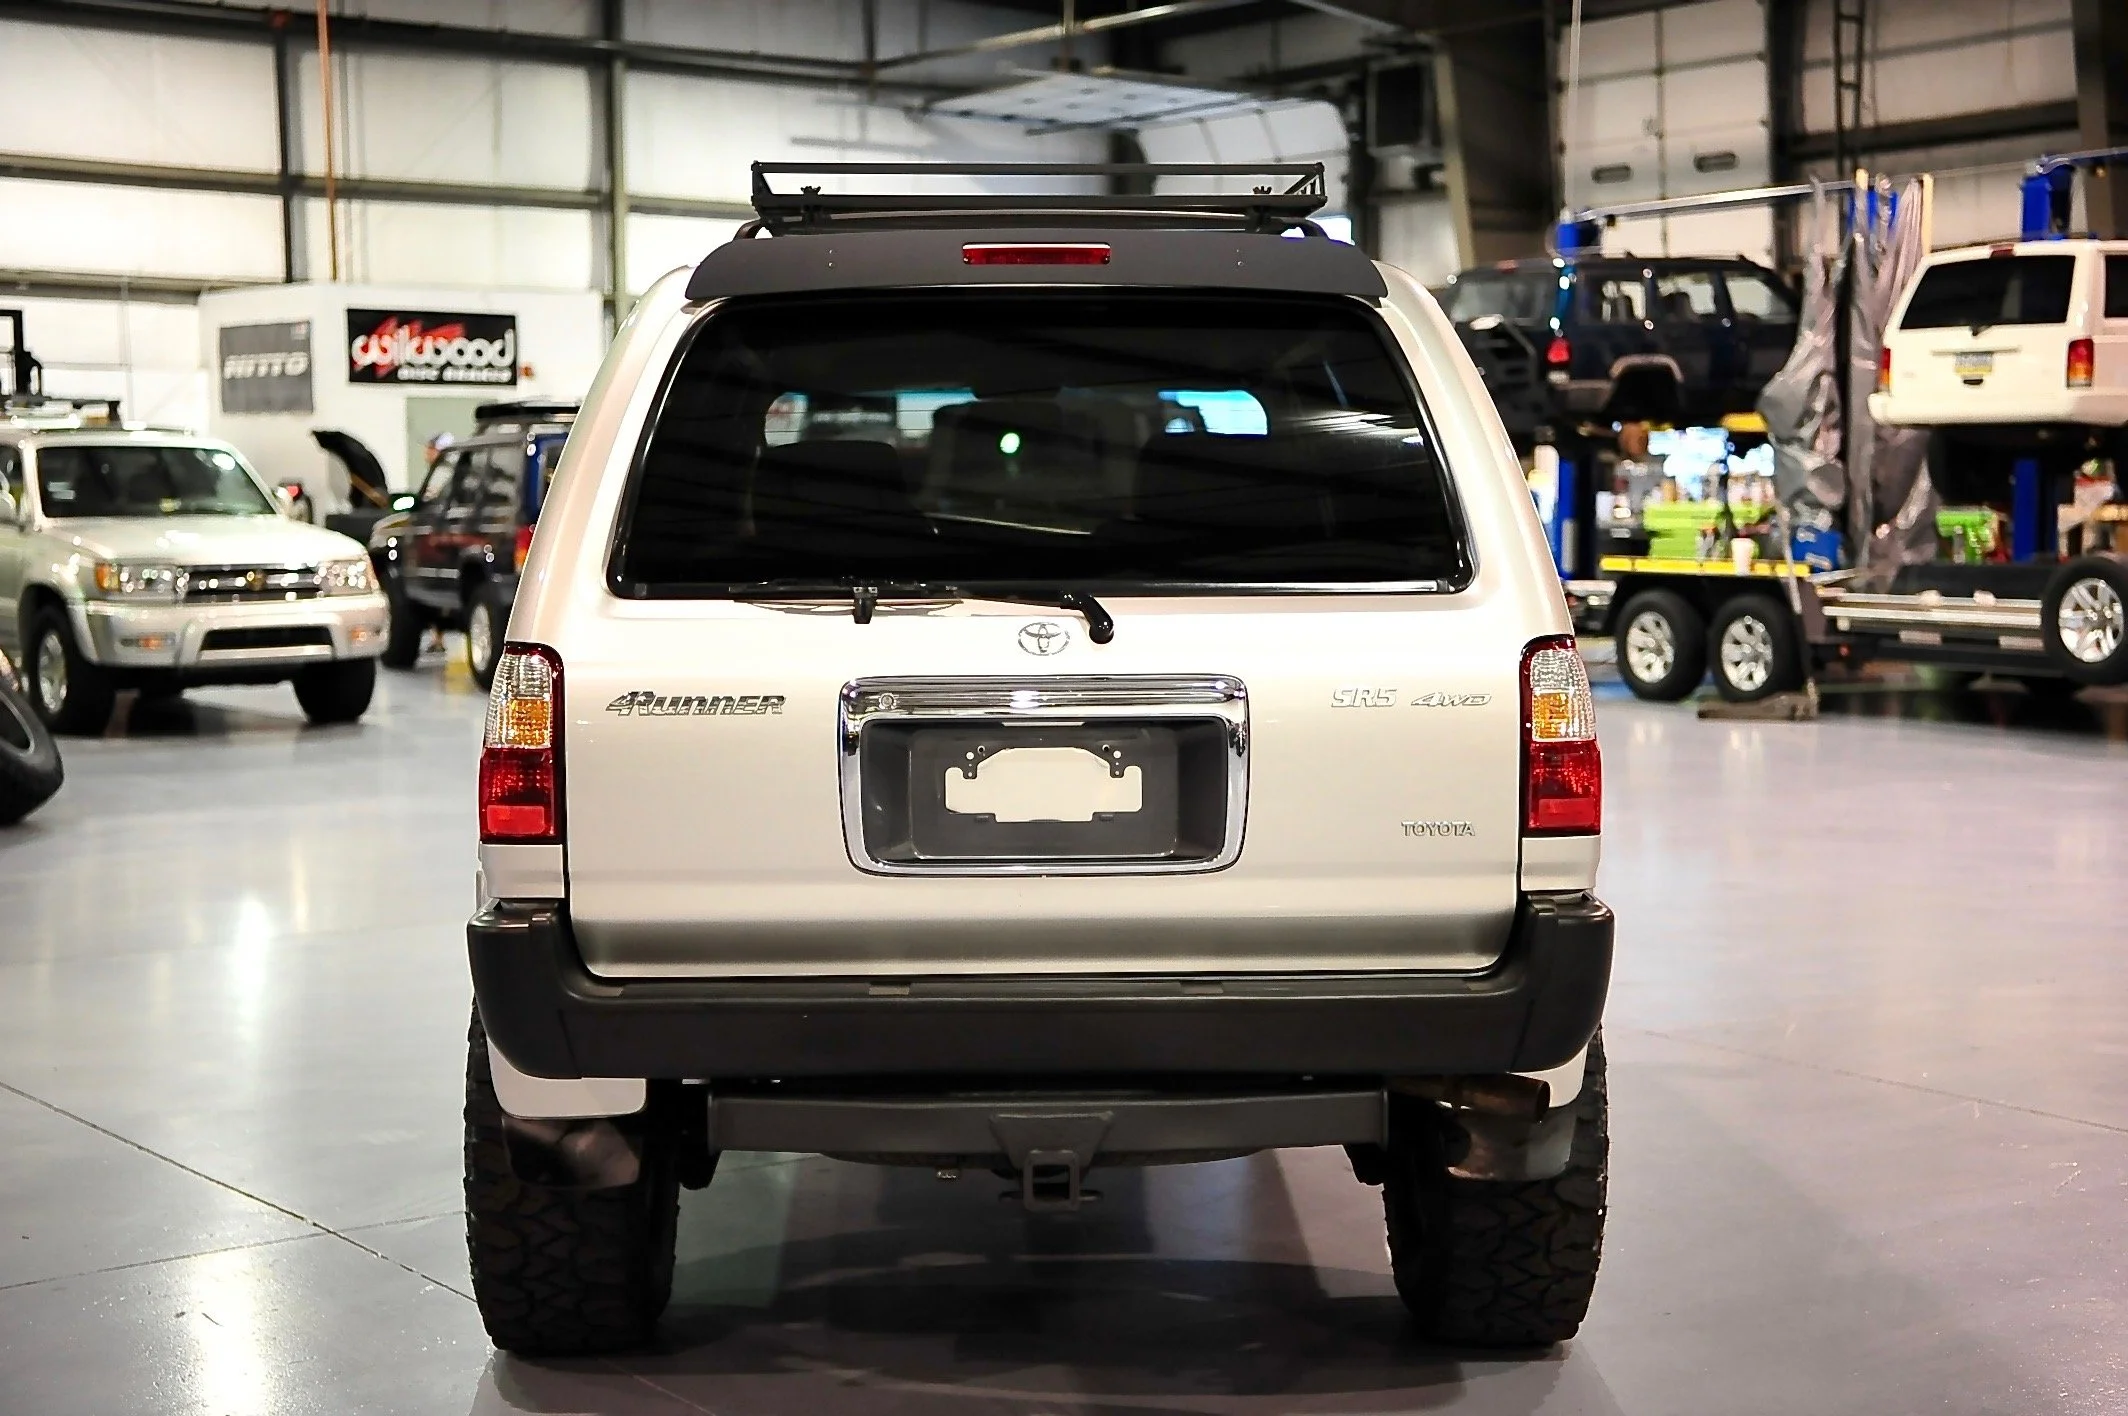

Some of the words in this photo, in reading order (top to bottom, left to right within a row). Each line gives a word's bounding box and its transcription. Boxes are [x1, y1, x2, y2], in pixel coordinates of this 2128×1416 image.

[1330, 688, 1398, 708] SR5
[1410, 691, 1493, 707] 4WD
[1400, 820, 1476, 837] TOYOTA
